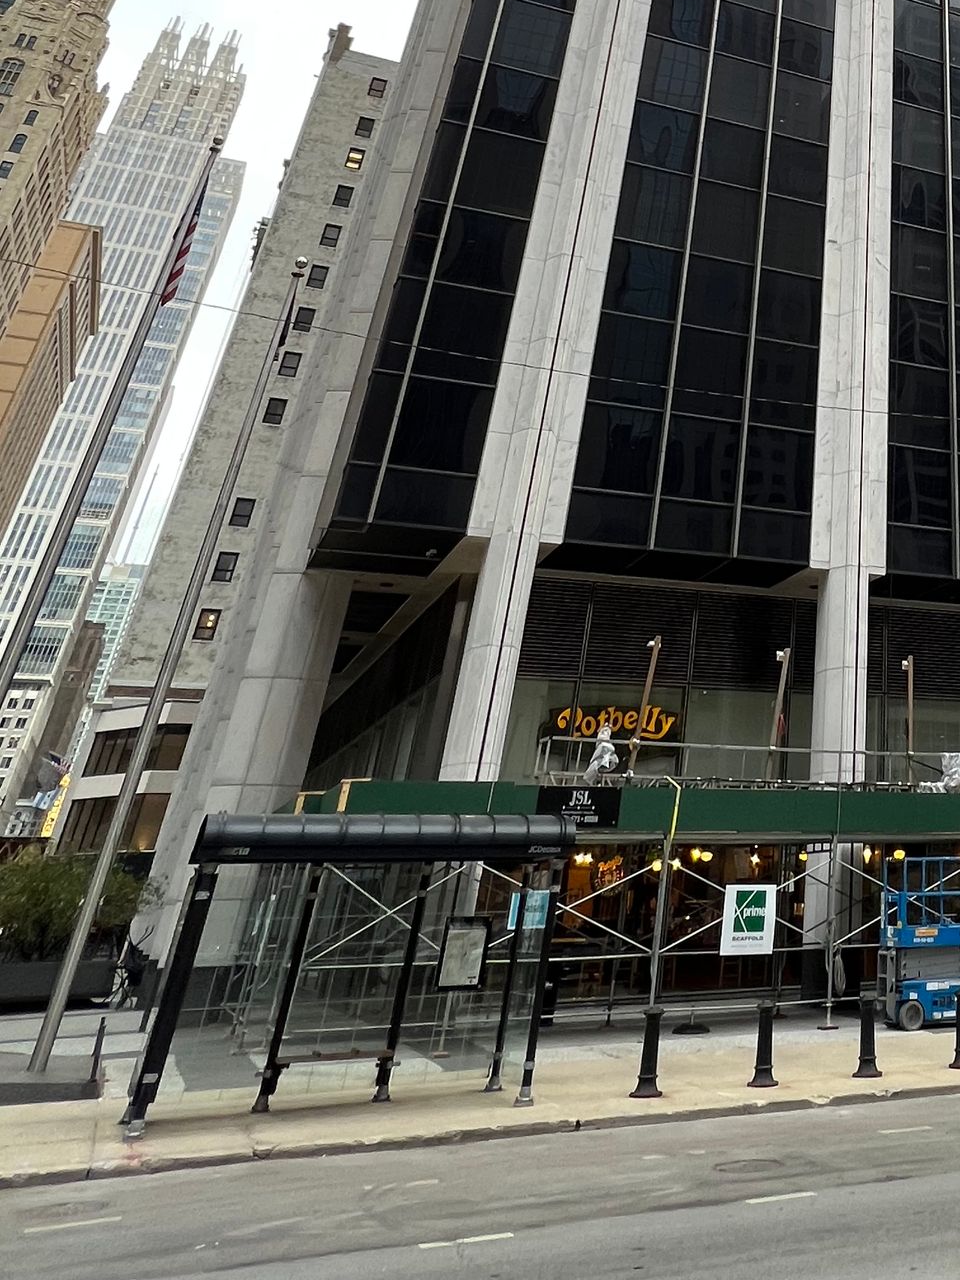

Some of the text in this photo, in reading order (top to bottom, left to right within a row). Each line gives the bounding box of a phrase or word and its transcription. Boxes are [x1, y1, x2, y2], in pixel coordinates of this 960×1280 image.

[557, 705, 676, 740] Potbelly
[569, 790, 592, 806] JSL
[743, 905, 766, 920] prime
